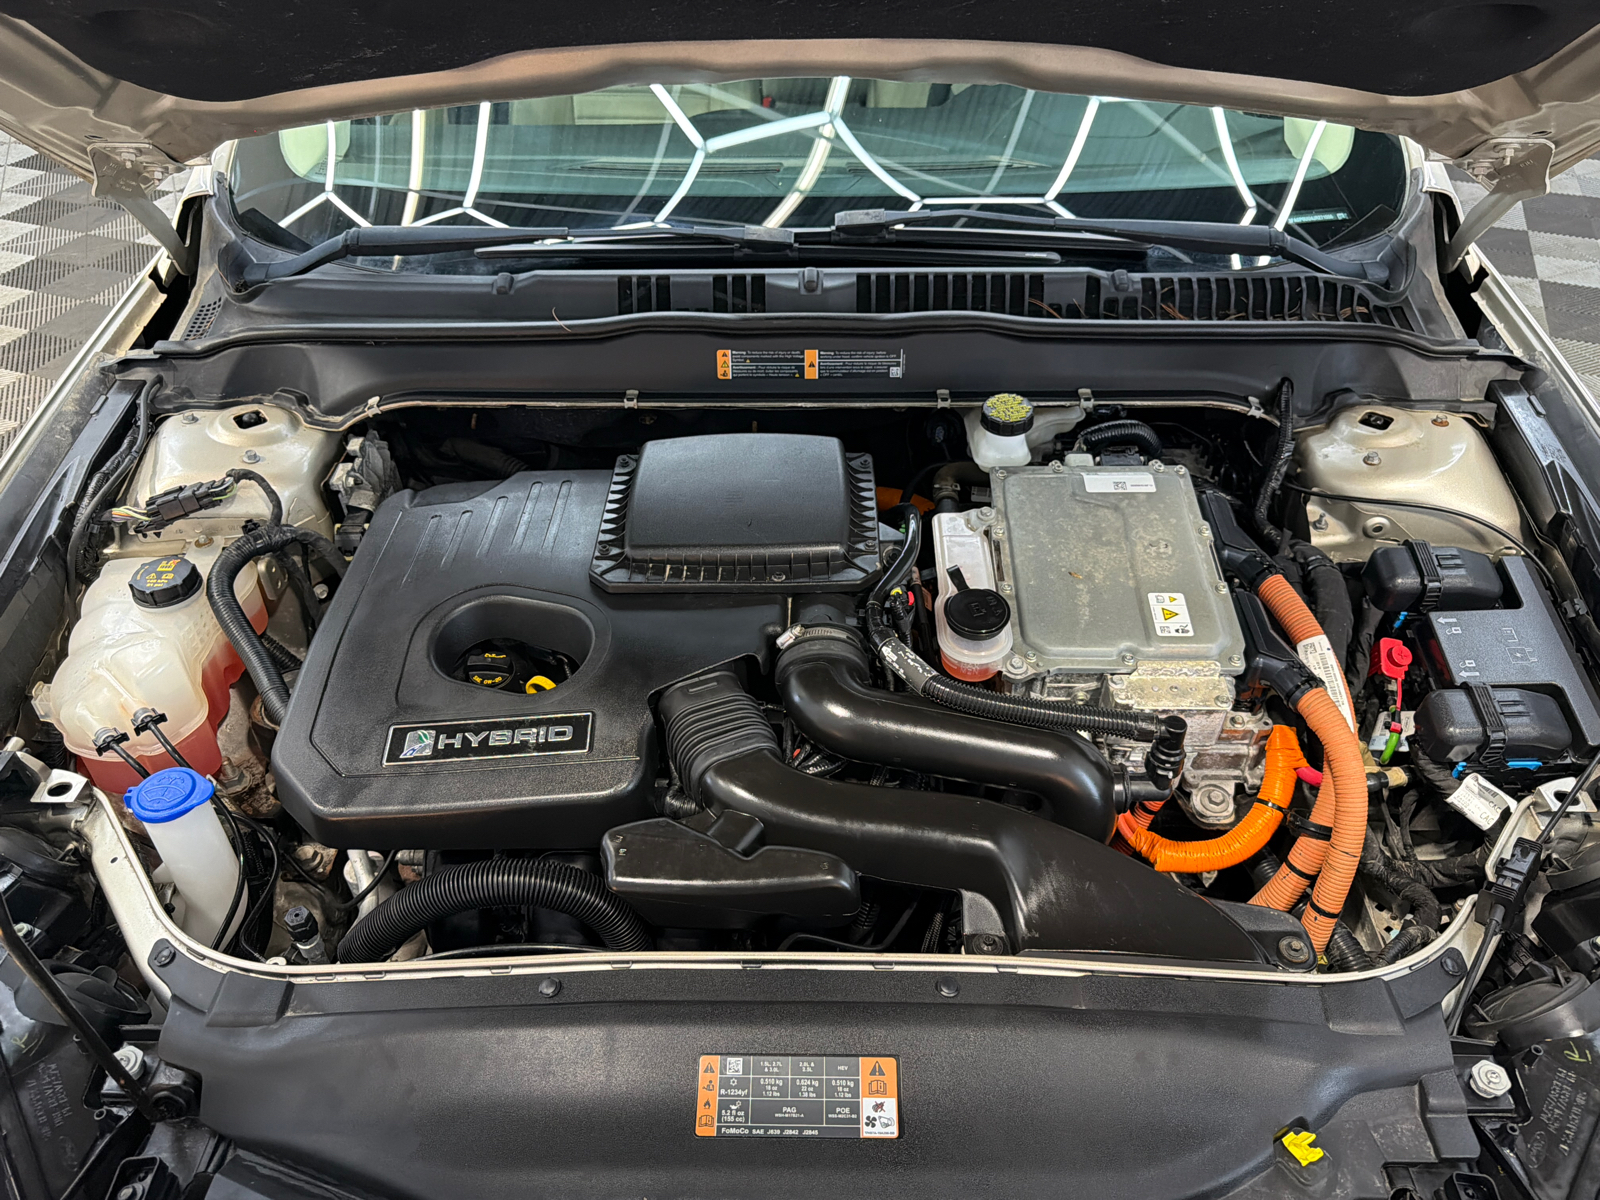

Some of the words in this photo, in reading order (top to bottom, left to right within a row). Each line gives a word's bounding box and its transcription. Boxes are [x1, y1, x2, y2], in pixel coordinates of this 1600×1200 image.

[473, 675, 483, 683] SAE
[484, 676, 502, 684] 0W-20
[438, 725, 574, 750] HYBRID
